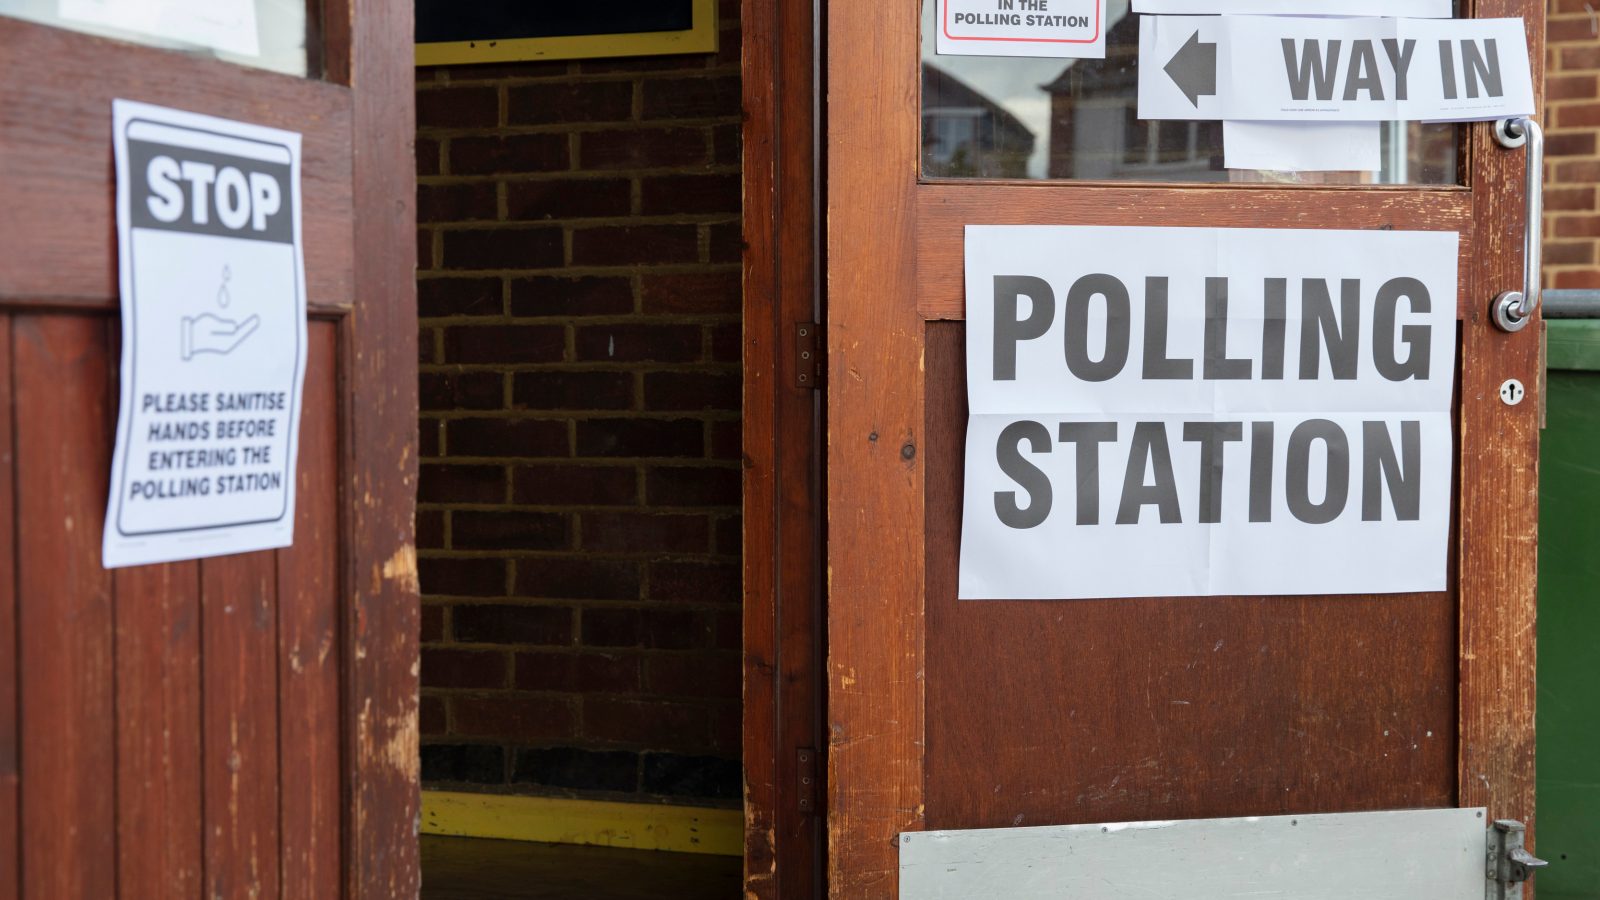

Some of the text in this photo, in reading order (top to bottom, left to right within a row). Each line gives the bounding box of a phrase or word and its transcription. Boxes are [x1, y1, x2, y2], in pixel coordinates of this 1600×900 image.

[997, 0, 1048, 11] IN THE
[954, 13, 1089, 28] POLLING STATION
[1280, 38, 1504, 101] WAY IN
[146, 155, 281, 231] STOP
[992, 273, 1433, 383] POLLING
[142, 392, 286, 413] PLEASE SANITISE
[148, 419, 276, 441] HANDS BEFORE
[148, 445, 271, 470] ENTERING THE
[130, 472, 281, 500] POLLING STATION
[993, 418, 1421, 530] STATION
